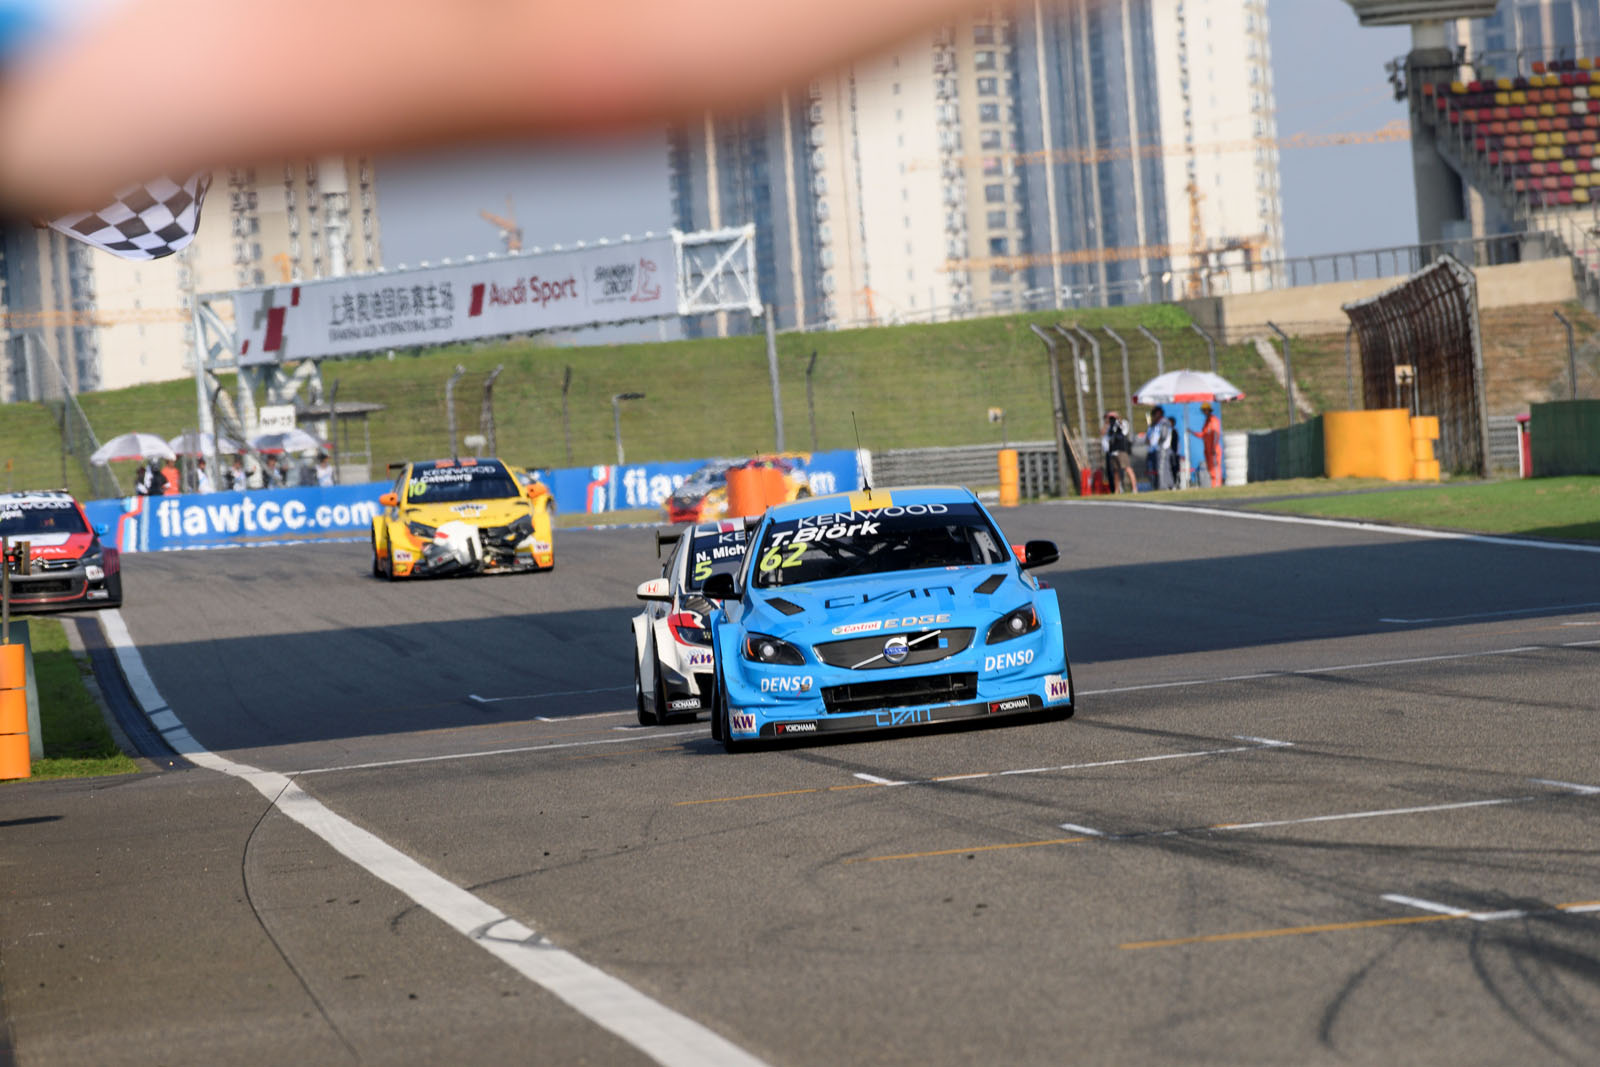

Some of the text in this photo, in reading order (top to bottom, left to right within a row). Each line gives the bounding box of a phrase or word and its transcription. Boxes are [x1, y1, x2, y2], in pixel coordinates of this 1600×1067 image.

[489, 278, 526, 306] Audi
[530, 273, 578, 308] Sport
[409, 481, 427, 497] 10
[157, 497, 379, 538] fiawtcc.com
[798, 504, 948, 529] KENWOOD
[713, 544, 747, 559] Mich
[759, 542, 808, 572] 62
[695, 560, 712, 581] 5
[843, 614, 951, 633] Castrol EDGE
[690, 651, 713, 665] KW
[985, 649, 1034, 672] DENSO
[761, 676, 813, 692] DENSO
[1051, 681, 1068, 696] KW
[1000, 699, 1028, 711] YOKOHAMA
[733, 715, 753, 728] KW
[785, 723, 816, 733] YOKOHAMA
